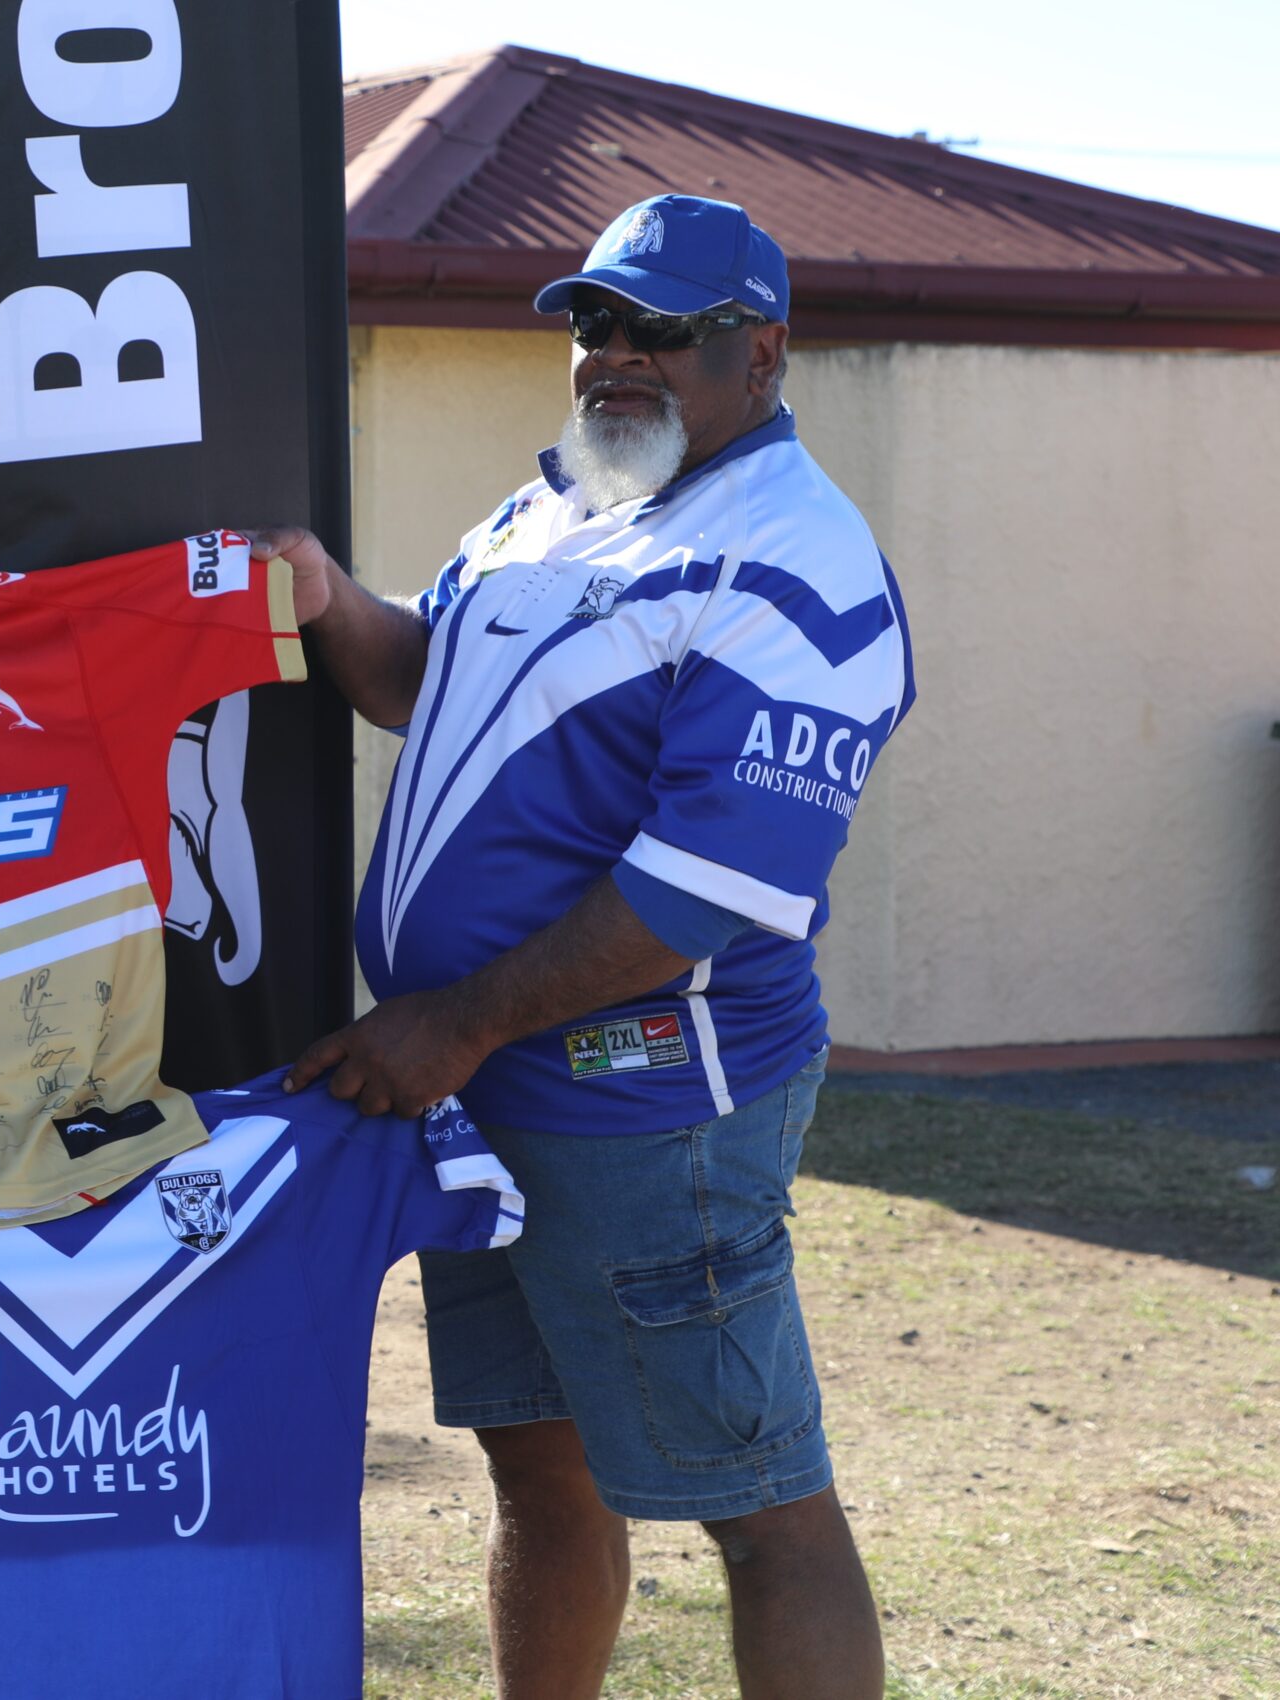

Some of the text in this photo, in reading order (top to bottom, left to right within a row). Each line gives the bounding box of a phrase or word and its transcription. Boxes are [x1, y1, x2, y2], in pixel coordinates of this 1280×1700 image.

[740, 709, 871, 792] ADCO
[608, 1027, 642, 1051] 2XL
[573, 1047, 603, 1060] NRL
[161, 1173, 218, 1190] BULLDOGS
